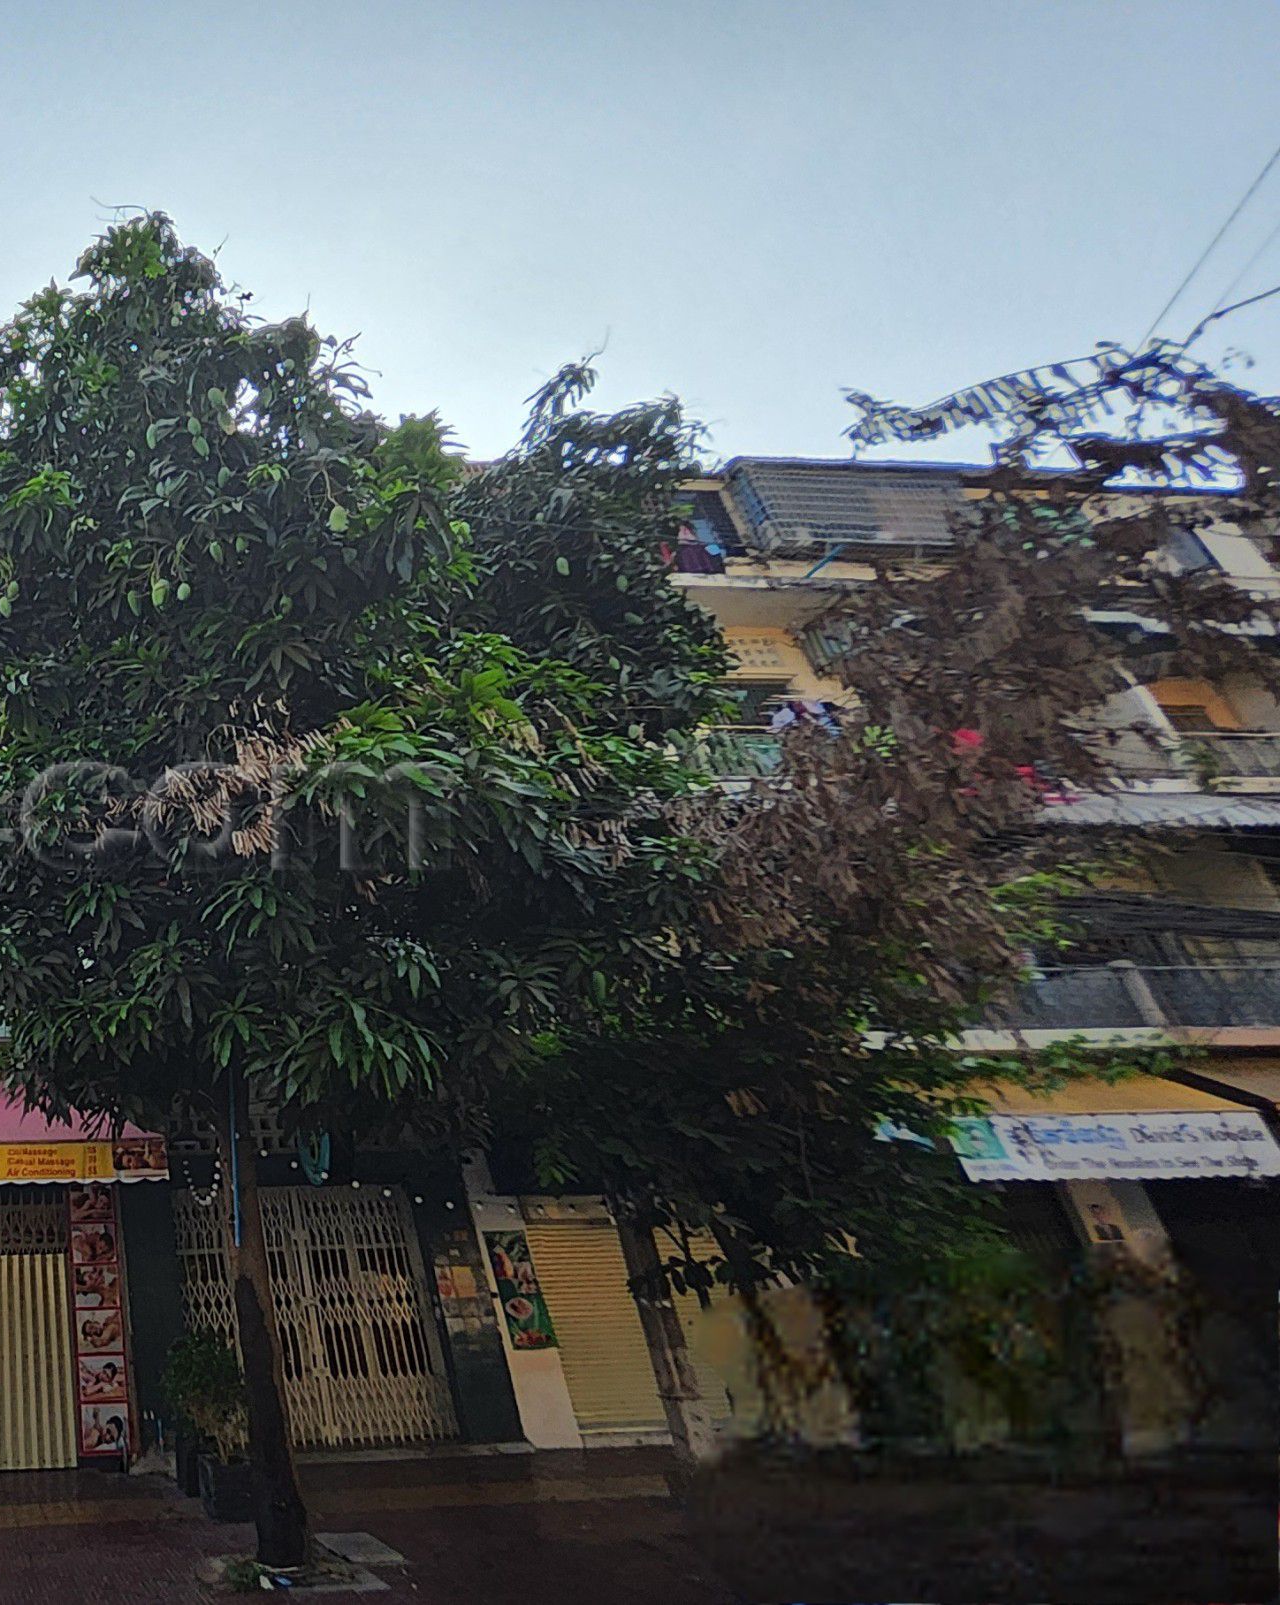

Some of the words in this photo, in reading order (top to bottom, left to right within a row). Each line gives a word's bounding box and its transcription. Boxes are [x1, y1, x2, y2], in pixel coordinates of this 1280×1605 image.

[37, 1158, 75, 1167] Massage
[7, 1168, 20, 1177] Air
[21, 1167, 76, 1177] Conditioning
